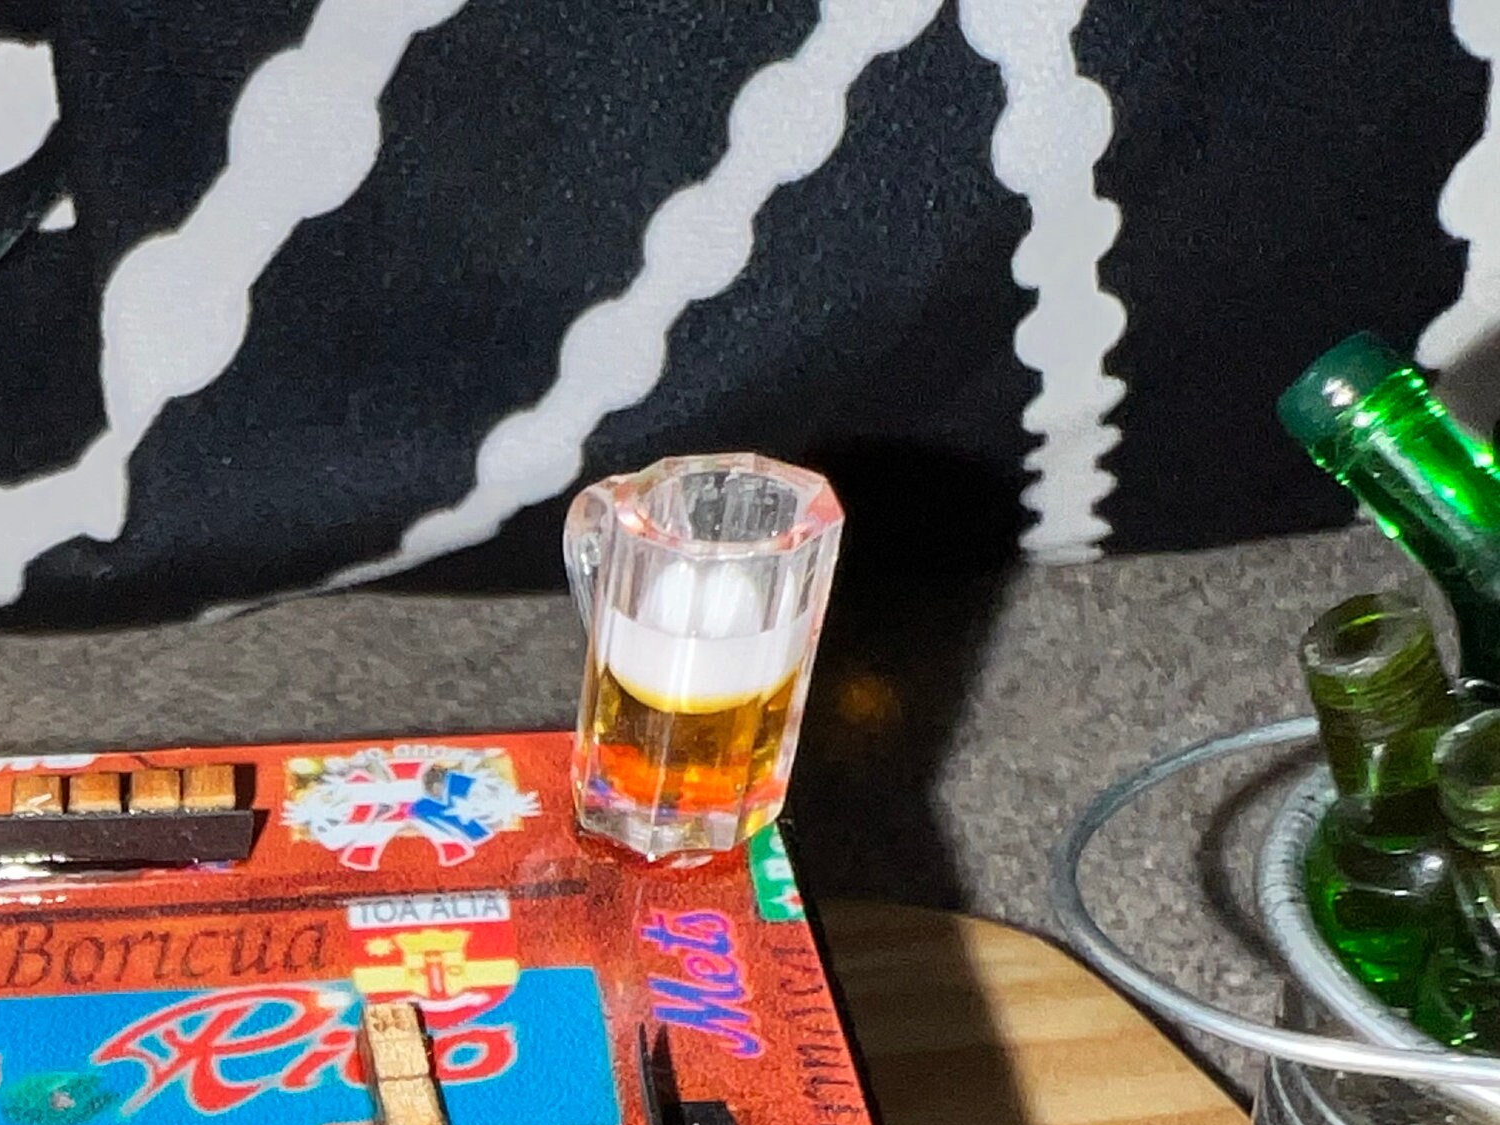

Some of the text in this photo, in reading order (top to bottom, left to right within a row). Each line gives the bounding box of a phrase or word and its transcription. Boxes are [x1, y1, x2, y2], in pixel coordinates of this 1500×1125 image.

[354, 894, 504, 924] TOA ALTA
[640, 907, 763, 1057] Mets
[90, 983, 518, 1117] Rio
